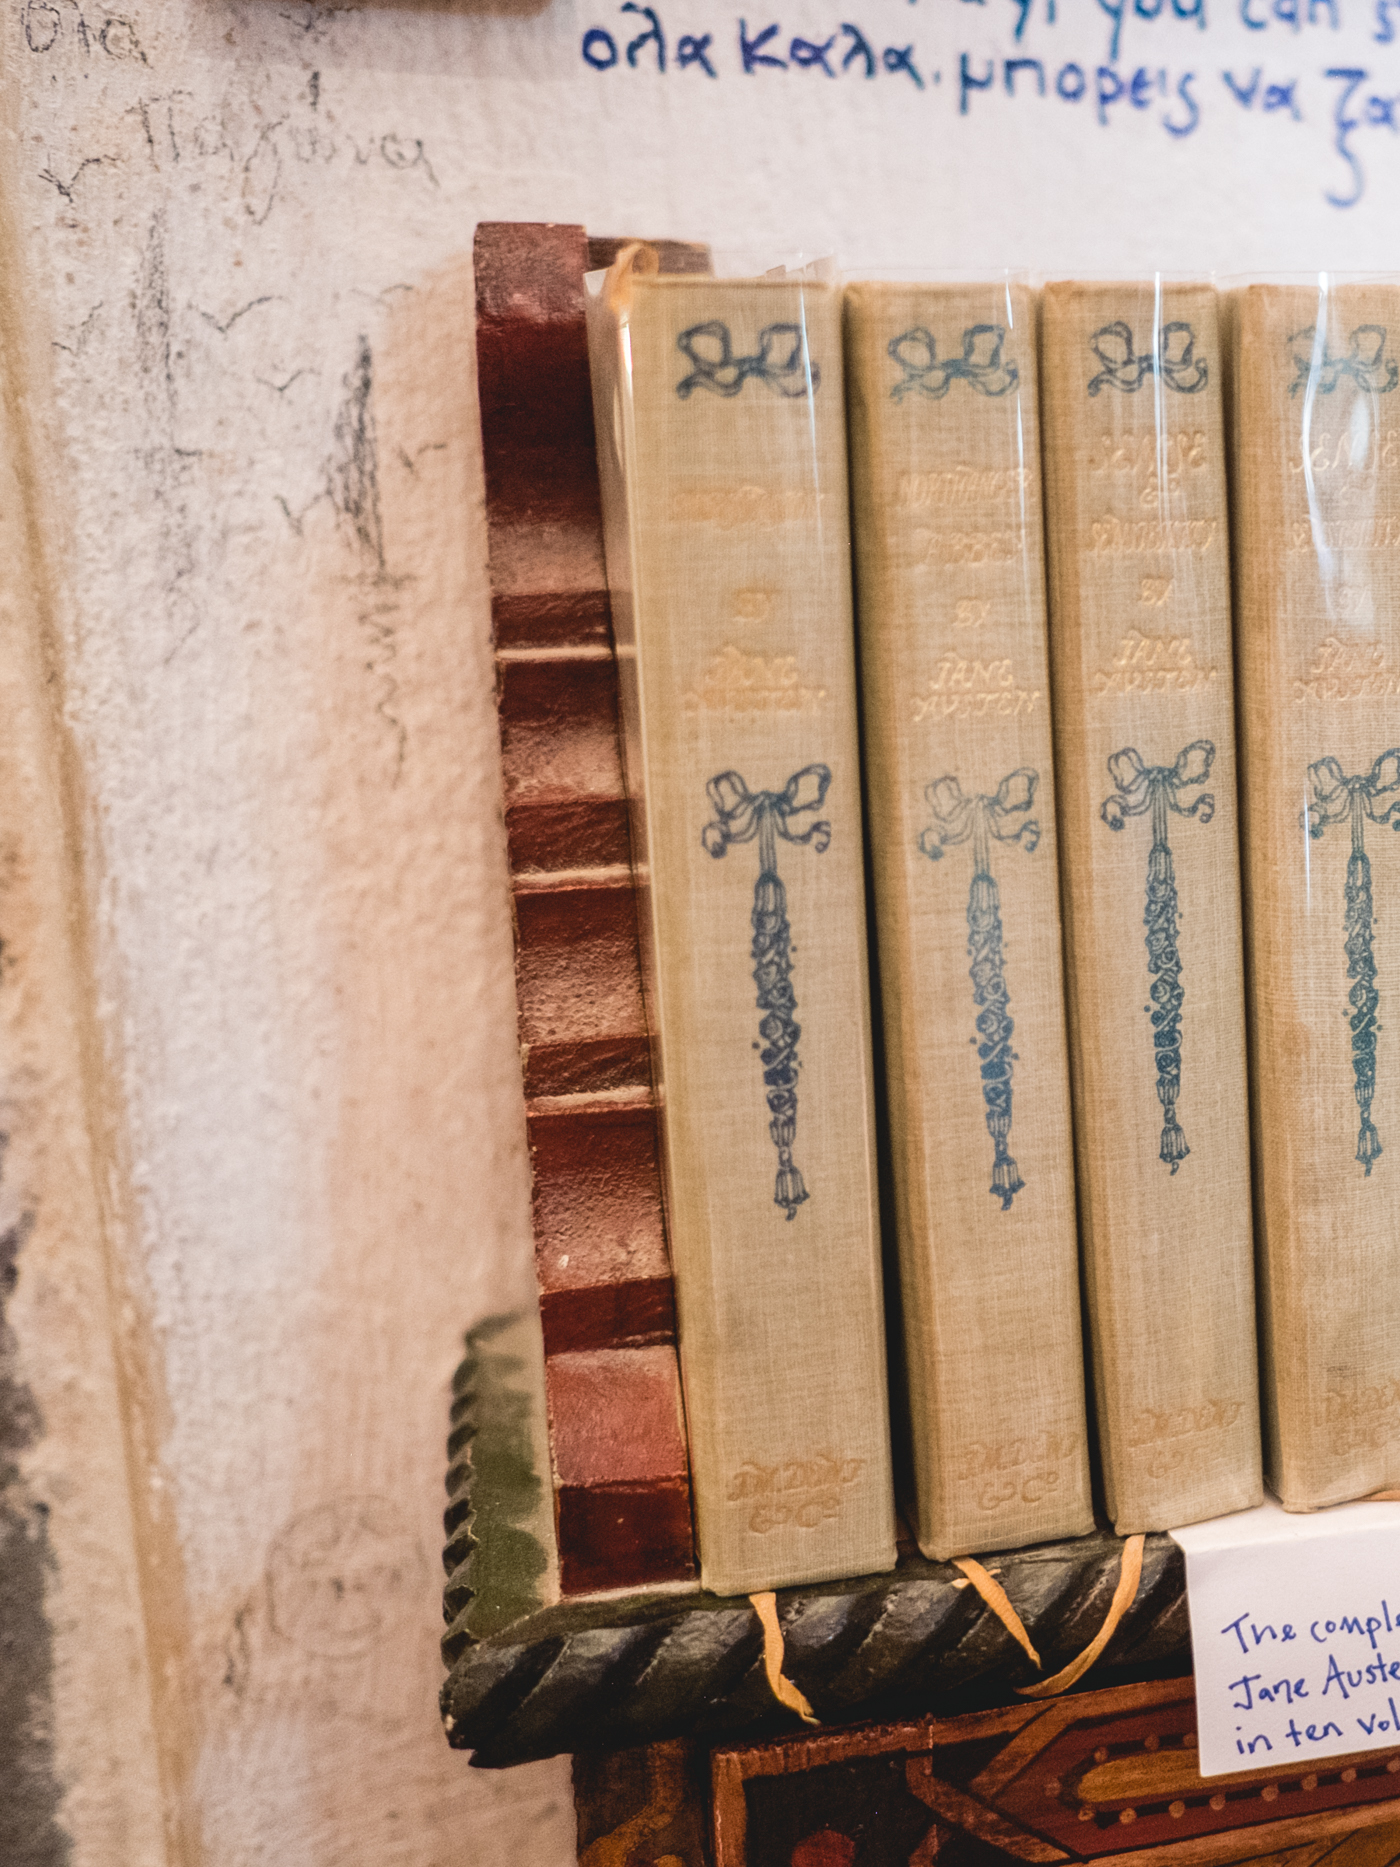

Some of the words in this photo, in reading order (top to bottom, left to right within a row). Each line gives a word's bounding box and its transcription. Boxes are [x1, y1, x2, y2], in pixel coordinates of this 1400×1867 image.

[928, 651, 1014, 690] JANE
[1220, 1611, 1298, 1655] The
[1227, 1672, 1311, 1711] Jane
[1234, 1724, 1274, 1756] in
[1285, 1717, 1343, 1748] ten
